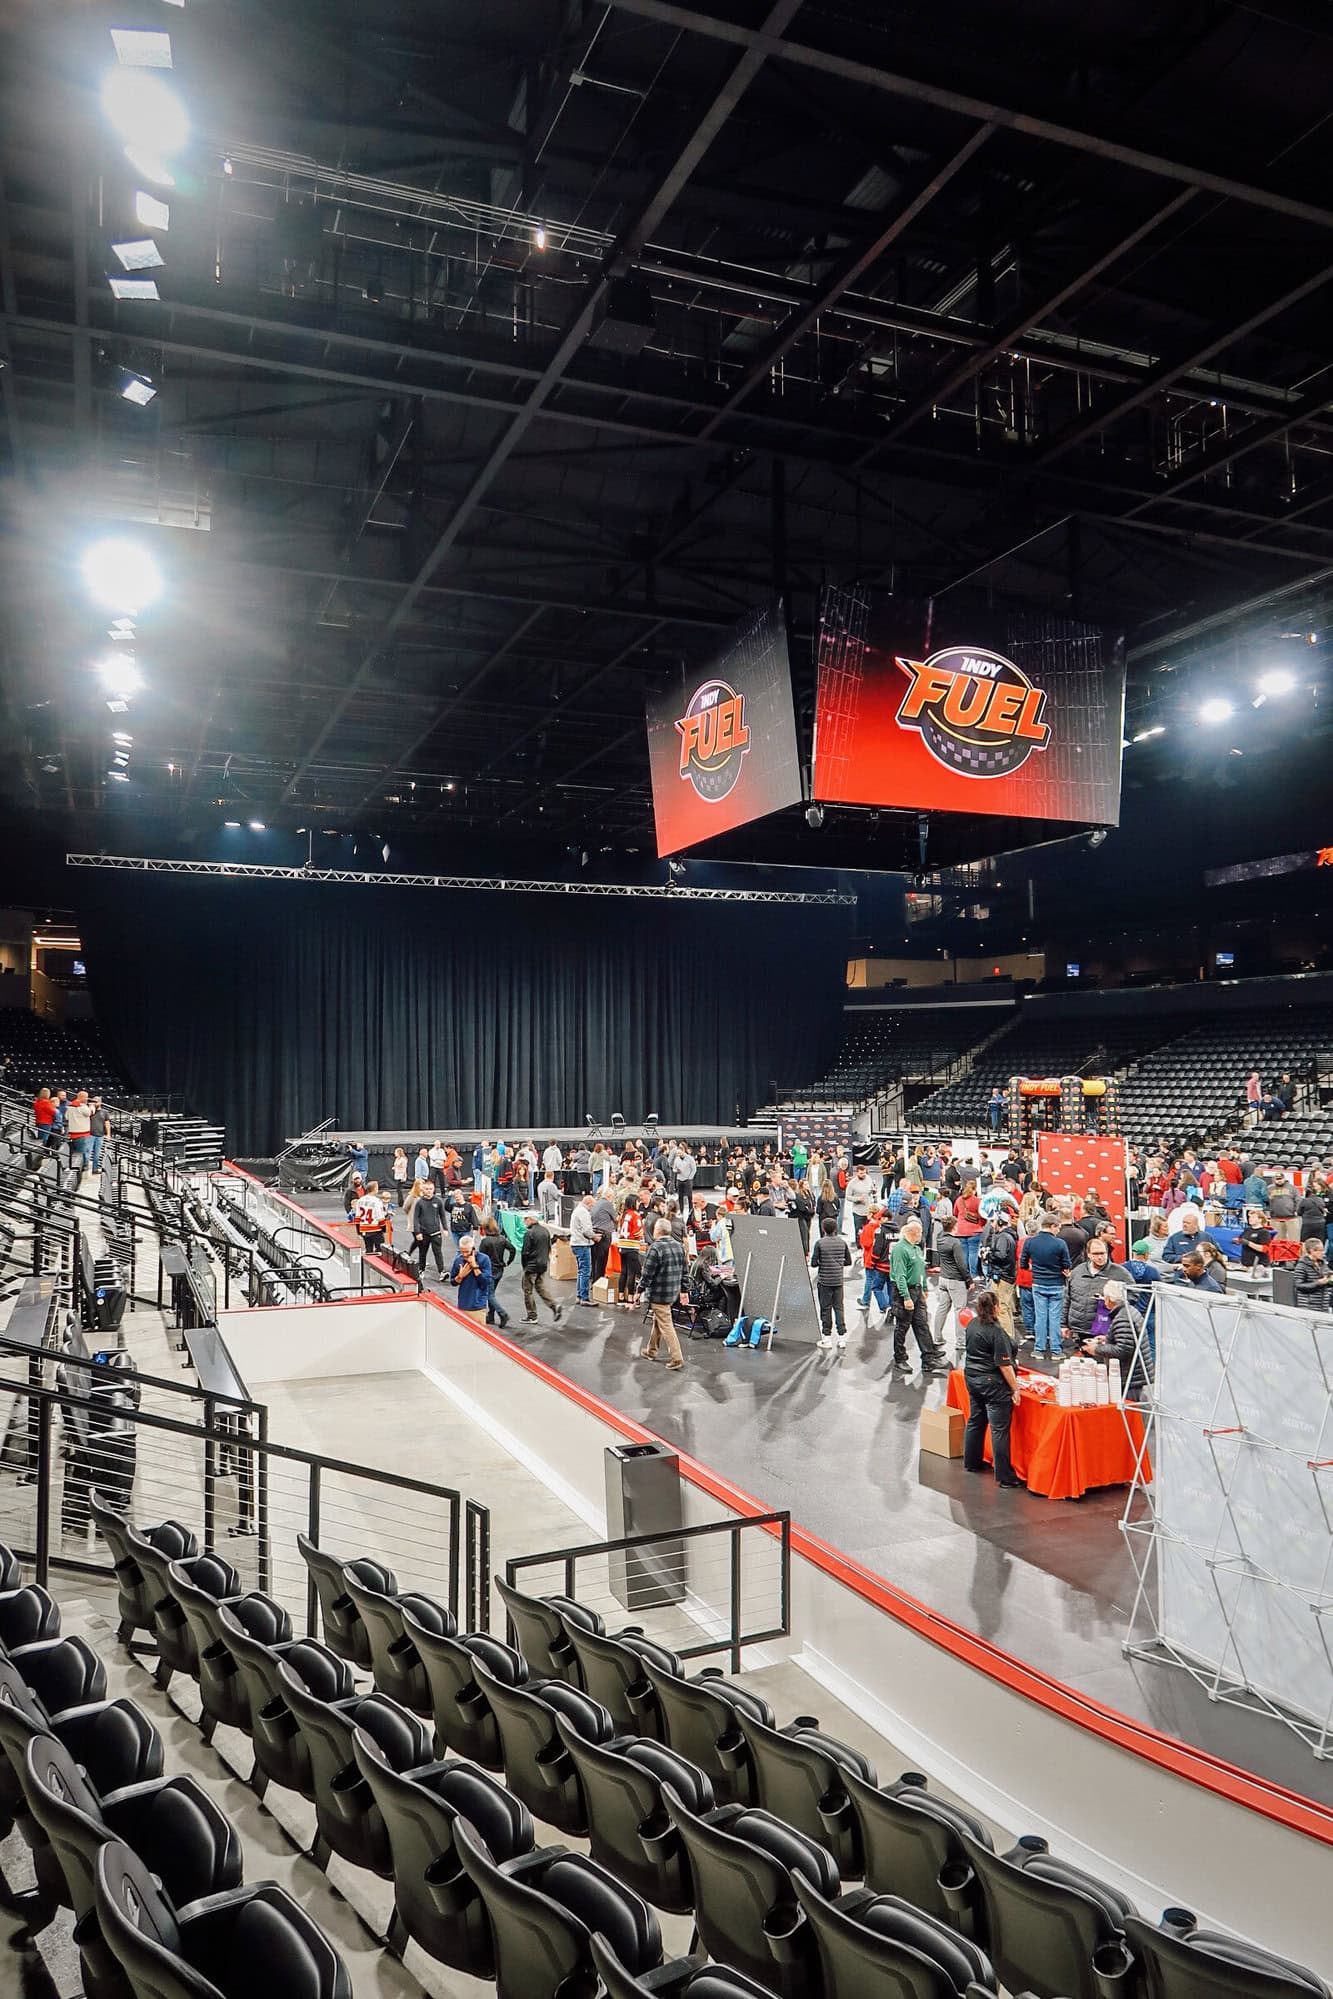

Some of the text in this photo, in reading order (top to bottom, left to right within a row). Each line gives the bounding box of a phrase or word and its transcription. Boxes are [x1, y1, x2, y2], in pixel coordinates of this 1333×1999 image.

[961, 656, 1003, 678] INDY
[700, 688, 720, 709] INDY
[901, 662, 1047, 740] FUEL
[680, 696, 748, 769] FUEL
[1021, 1082, 1058, 1092] INDY FUEL
[358, 1206, 374, 1224] 24
